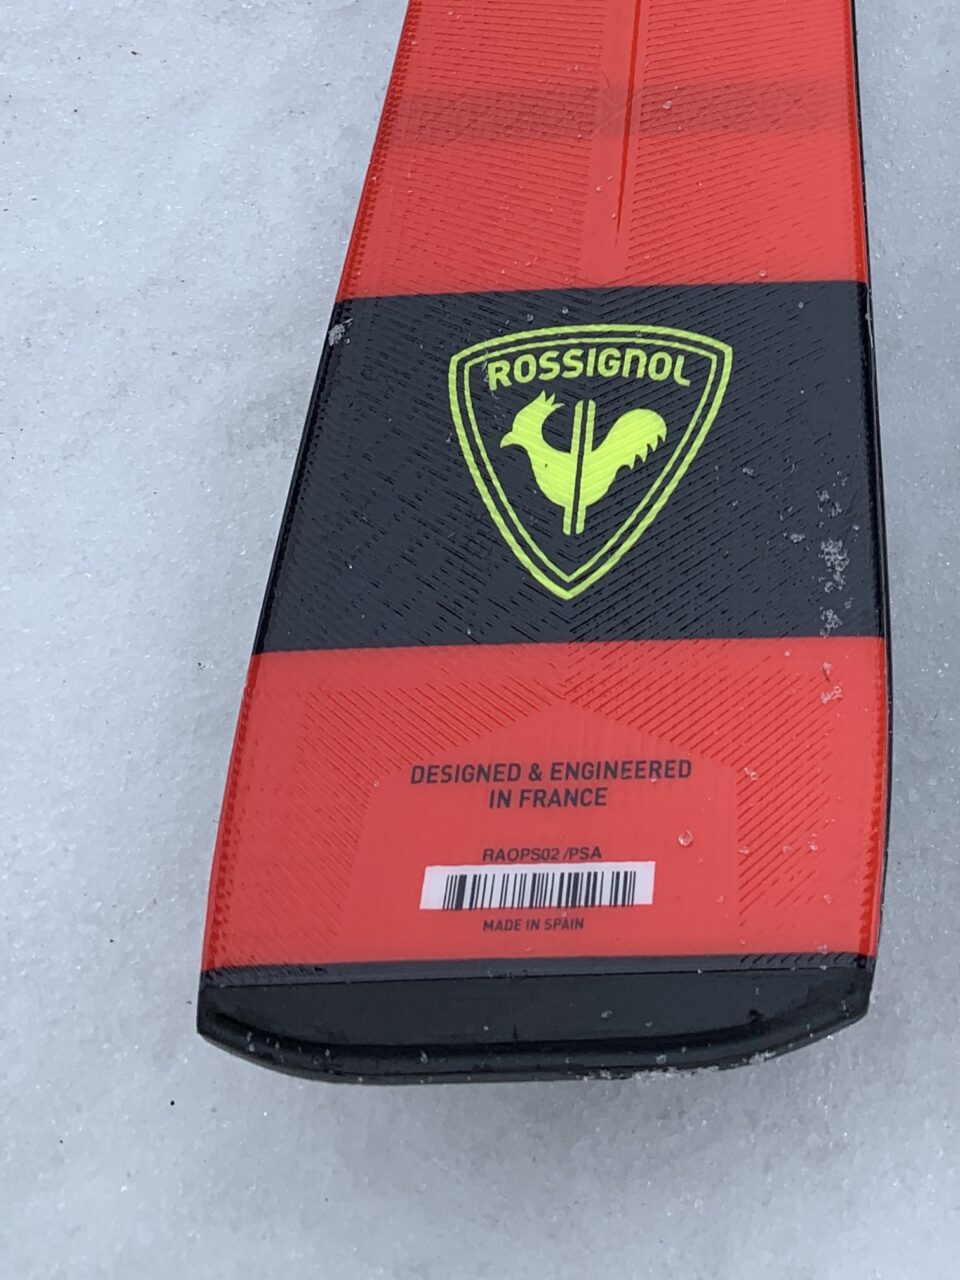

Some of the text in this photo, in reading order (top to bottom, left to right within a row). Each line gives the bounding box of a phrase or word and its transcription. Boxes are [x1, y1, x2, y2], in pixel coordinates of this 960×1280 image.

[486, 347, 692, 393] ROSSIGNOL
[410, 759, 692, 784] DESIGNED & ENGINEERED
[489, 787, 608, 808] IN FRANCE
[562, 846, 602, 861] /PSA
[482, 916, 584, 932] MADE IN SPAIN
